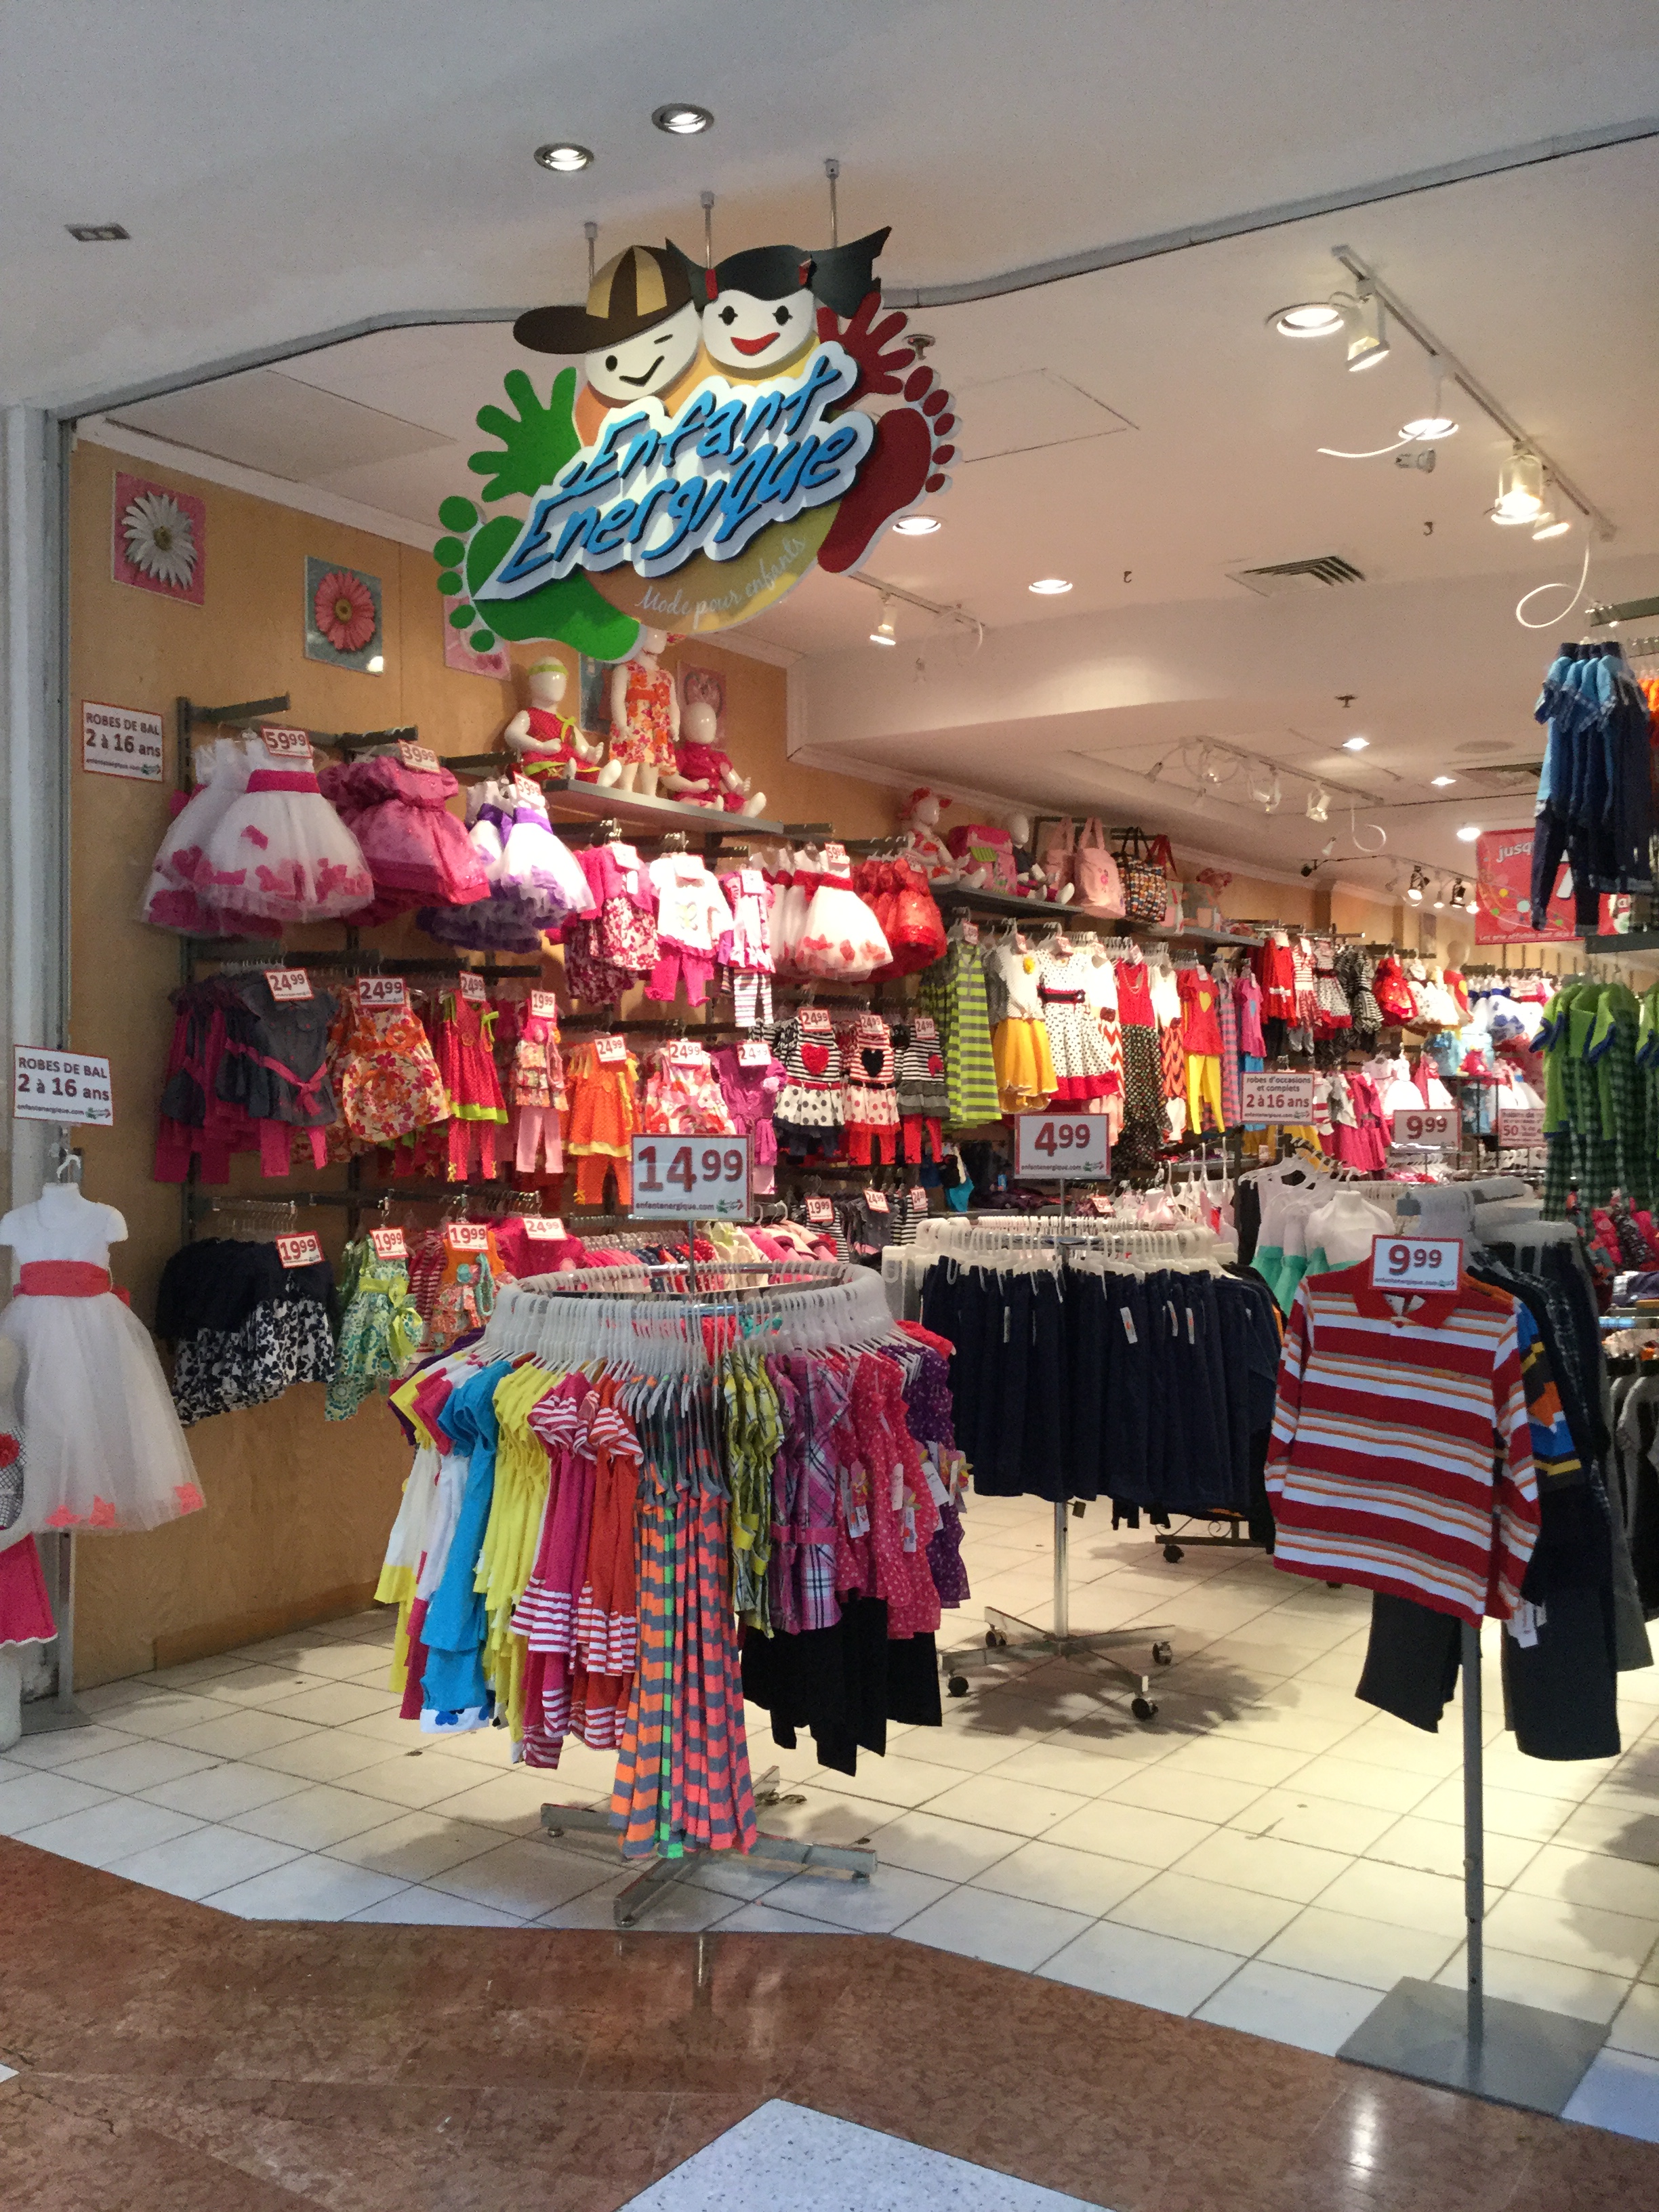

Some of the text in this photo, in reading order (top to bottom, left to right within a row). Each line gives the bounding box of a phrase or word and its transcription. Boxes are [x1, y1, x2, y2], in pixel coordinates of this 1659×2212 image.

[560, 356, 842, 493] Enfant
[497, 426, 857, 583] Energique
[634, 536, 806, 630] Mode pour enfants
[85, 712, 160, 736] ROBES DE BAL
[85, 728, 161, 757] 2 à 16 ans
[1496, 842, 1535, 863] jusq
[18, 1057, 108, 1079] ROBES DE BAL
[18, 1073, 110, 1101] 2 à 16 ans
[1266, 1084, 1300, 1092] complets
[1269, 1076, 1312, 1084] d'occasions
[1246, 1093, 1309, 1109] 2 à 16 ans
[636, 1201, 715, 1211] enfantenergique.com
